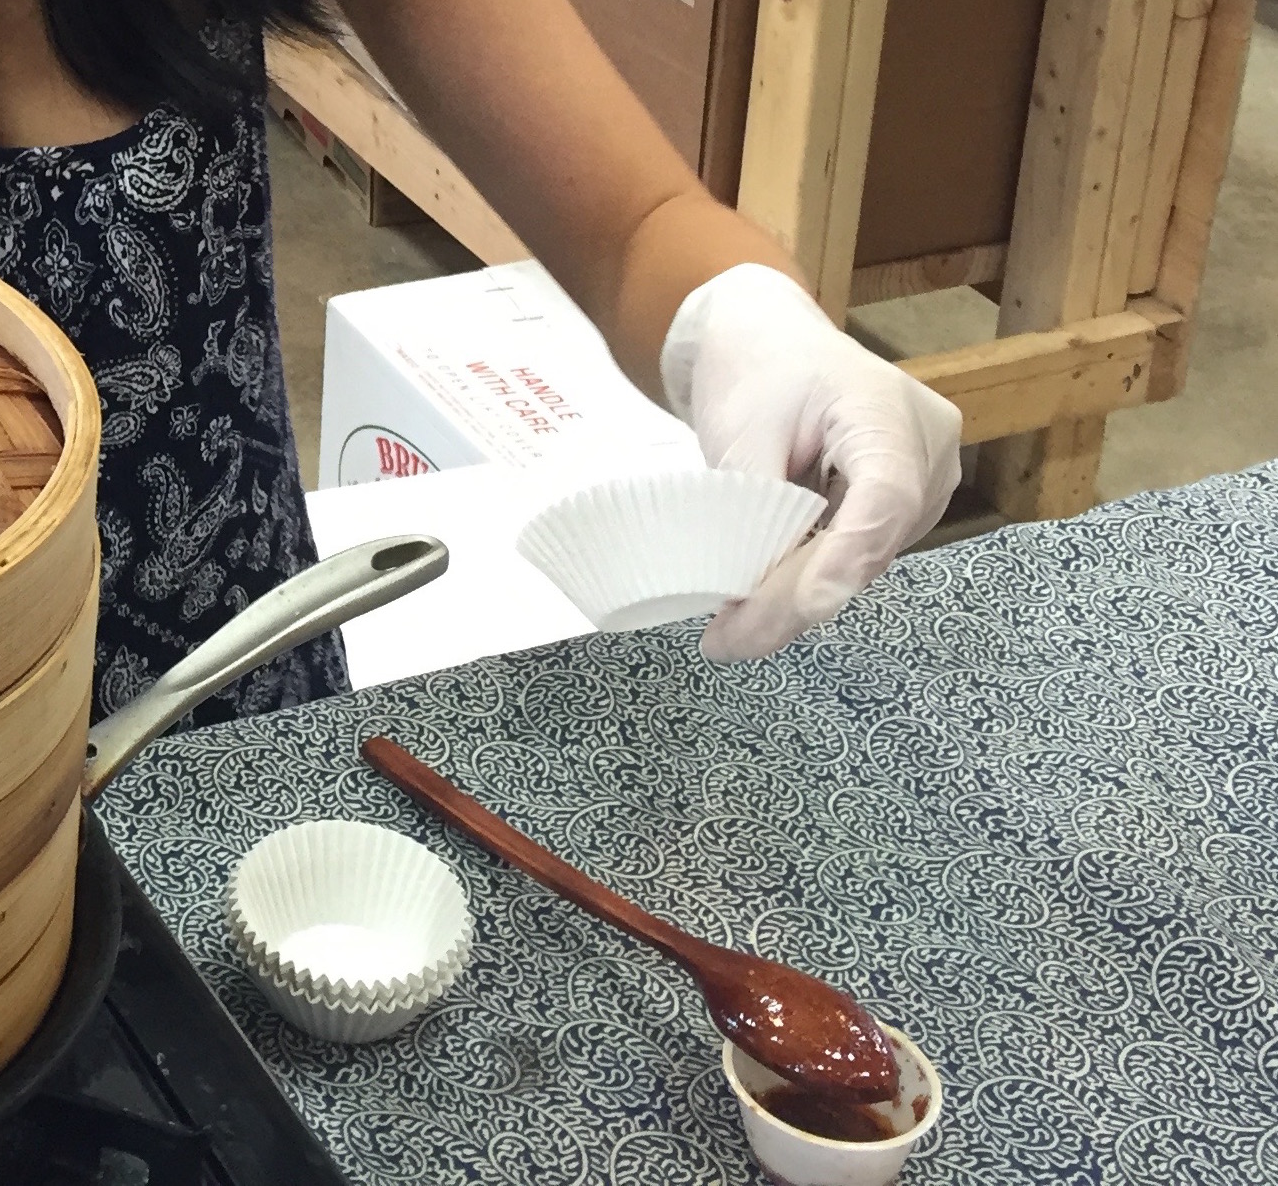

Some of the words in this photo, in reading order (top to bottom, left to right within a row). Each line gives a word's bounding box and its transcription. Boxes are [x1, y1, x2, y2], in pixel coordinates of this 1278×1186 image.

[466, 361, 517, 396] WITH
[505, 399, 559, 435] CARE
[510, 367, 584, 421] HANDLE
